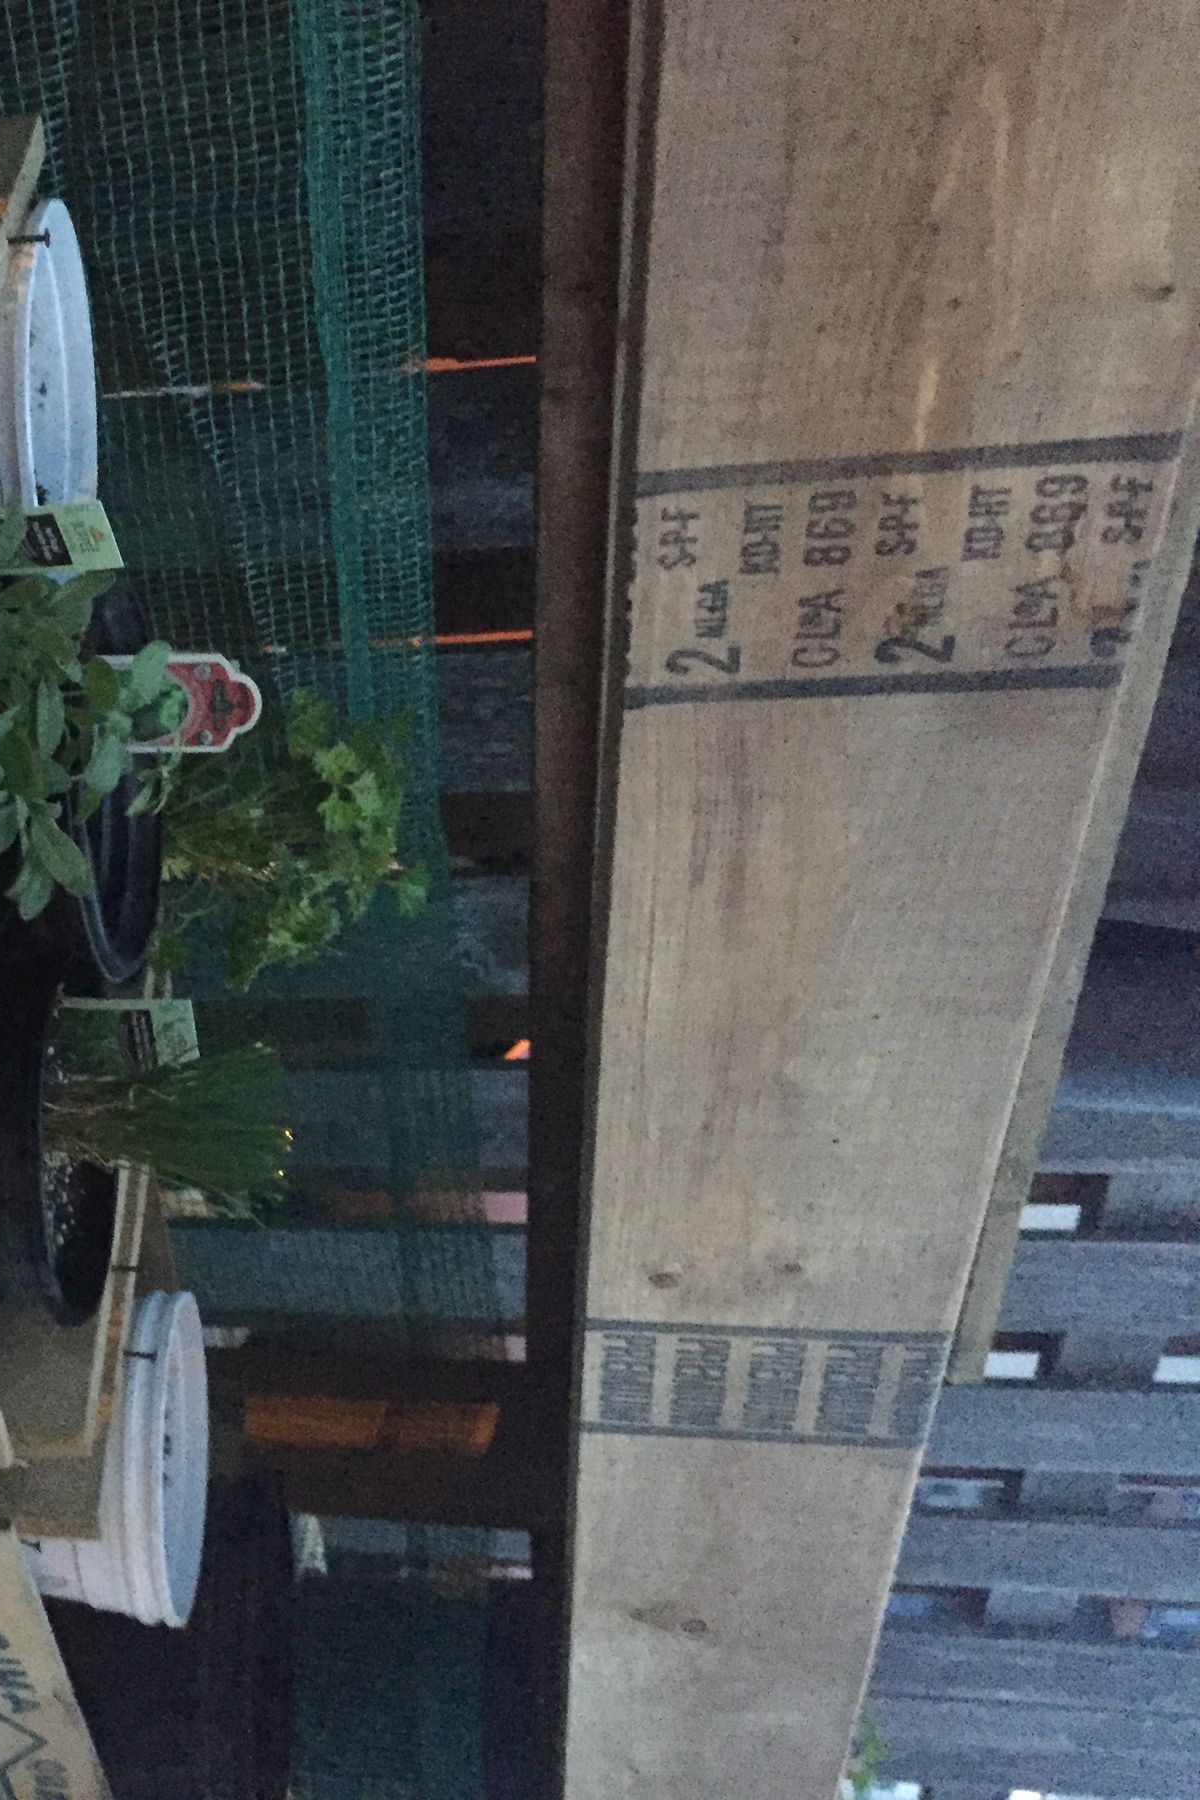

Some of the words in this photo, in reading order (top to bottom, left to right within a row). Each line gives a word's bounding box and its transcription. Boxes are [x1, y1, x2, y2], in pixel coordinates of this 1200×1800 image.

[803, 489, 858, 569] 869
[665, 645, 741, 676] 2
[874, 635, 956, 664] 2
